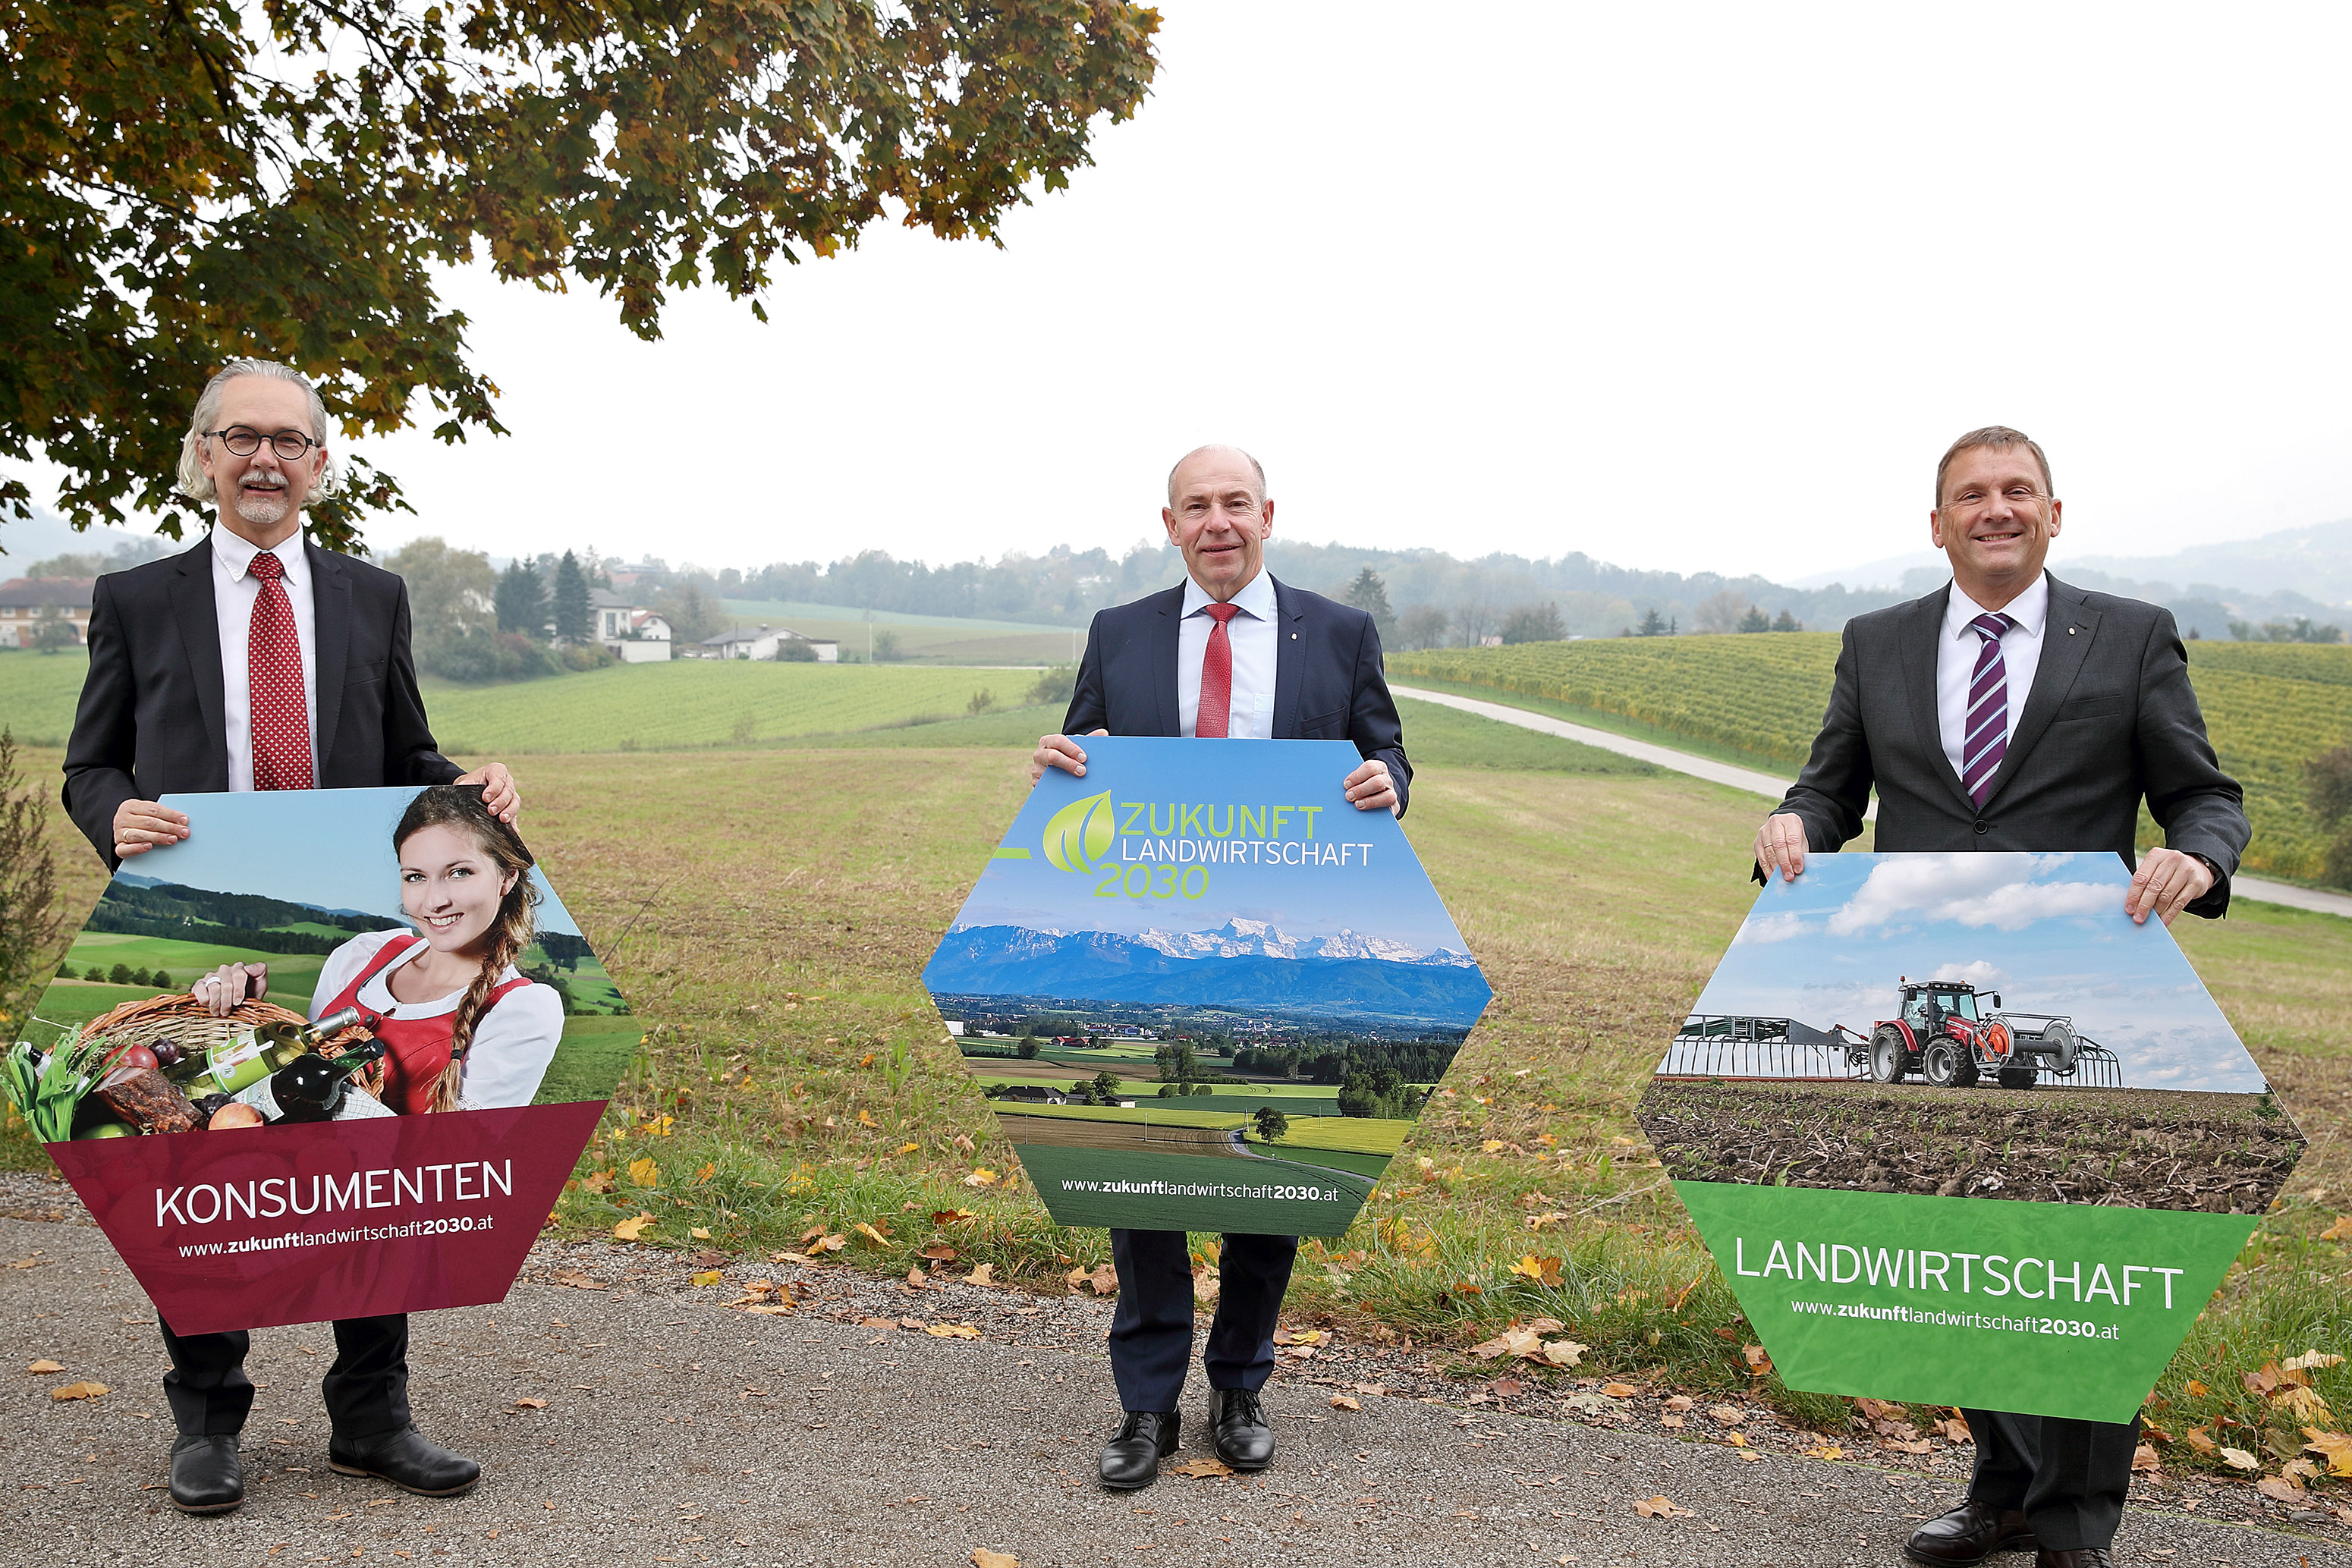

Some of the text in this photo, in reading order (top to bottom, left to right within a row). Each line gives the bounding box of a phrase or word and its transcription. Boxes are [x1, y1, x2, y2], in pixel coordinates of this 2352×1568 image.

[1120, 802, 1323, 839] ZUKUNFT
[1122, 838, 1374, 866] LANDWIRTSCHAFT
[1093, 863, 1209, 900] 2030
[156, 1159, 512, 1227] KONSUMENTEN
[1061, 1179, 1339, 1202] www.zukunftlandwirtschaft2030.at
[178, 1214, 494, 1258] www.zukunftlandwirtschaft2030.at
[1736, 1237, 2184, 1309] LANDWIRTSCHAFT
[1791, 1300, 2120, 1340] www.zukunftlandwirtschaft2030.at
